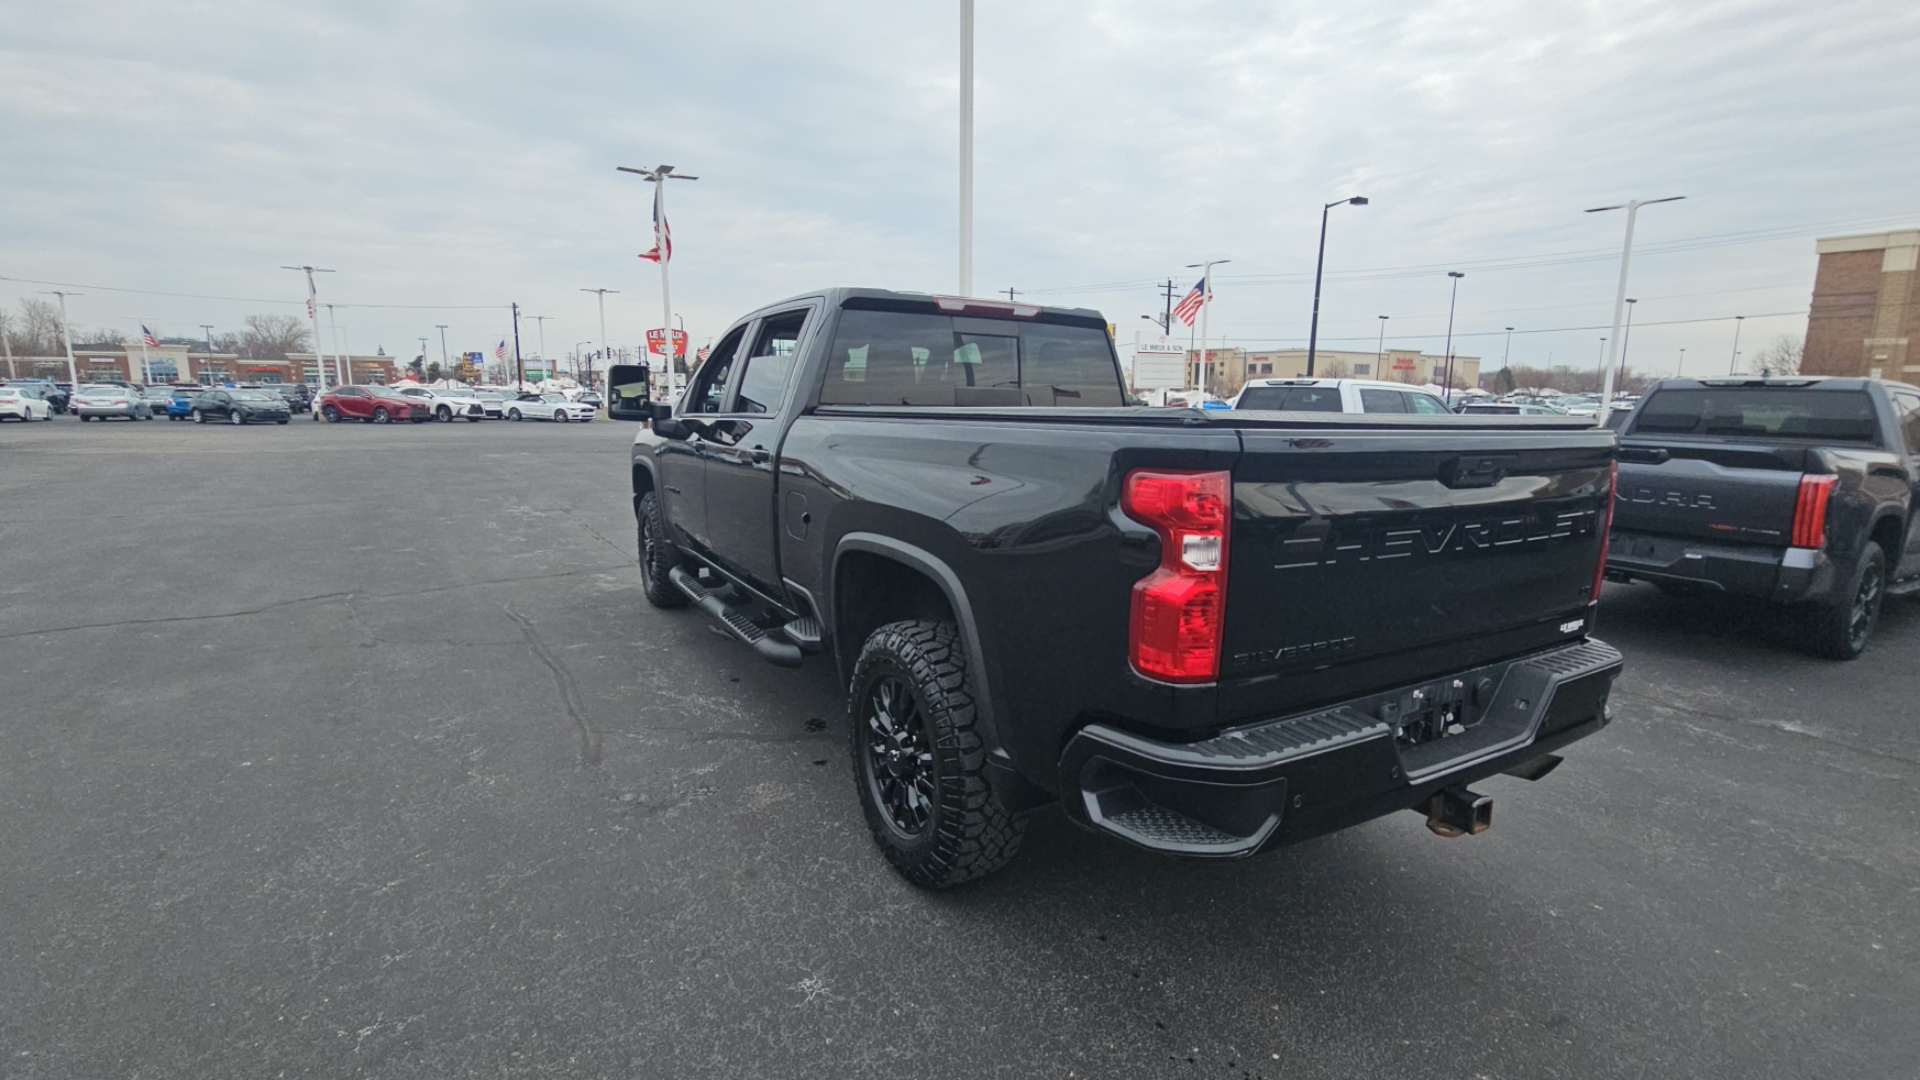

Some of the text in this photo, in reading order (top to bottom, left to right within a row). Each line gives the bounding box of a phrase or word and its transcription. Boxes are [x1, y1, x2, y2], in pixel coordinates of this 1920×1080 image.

[649, 329, 683, 340] LE MUX
[1141, 343, 1149, 351] LE
[1273, 508, 1597, 570] CHEVROLET
